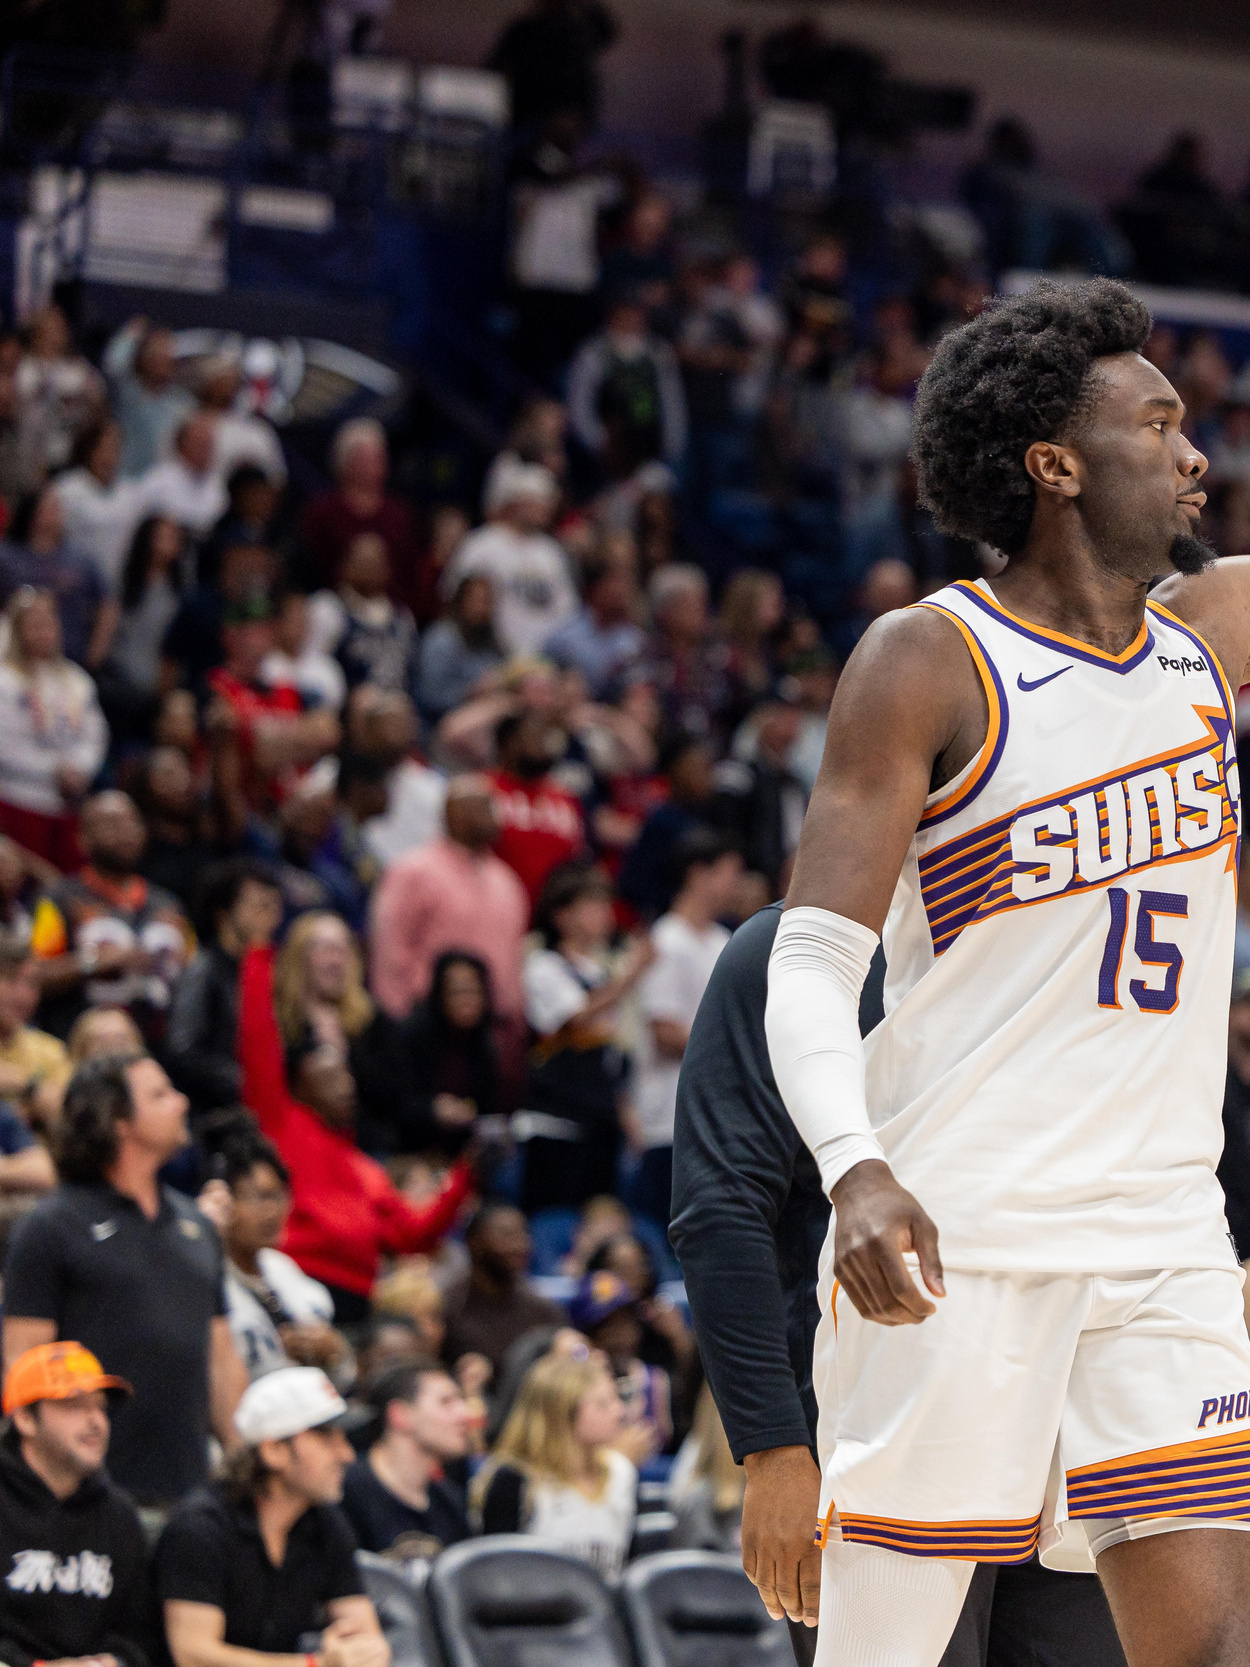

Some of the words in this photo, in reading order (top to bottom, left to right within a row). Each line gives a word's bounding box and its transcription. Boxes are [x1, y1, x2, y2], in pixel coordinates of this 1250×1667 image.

[1157, 655, 1208, 676] PayPal
[1009, 752, 1223, 901] SUNS
[1098, 887, 1189, 1014] 15
